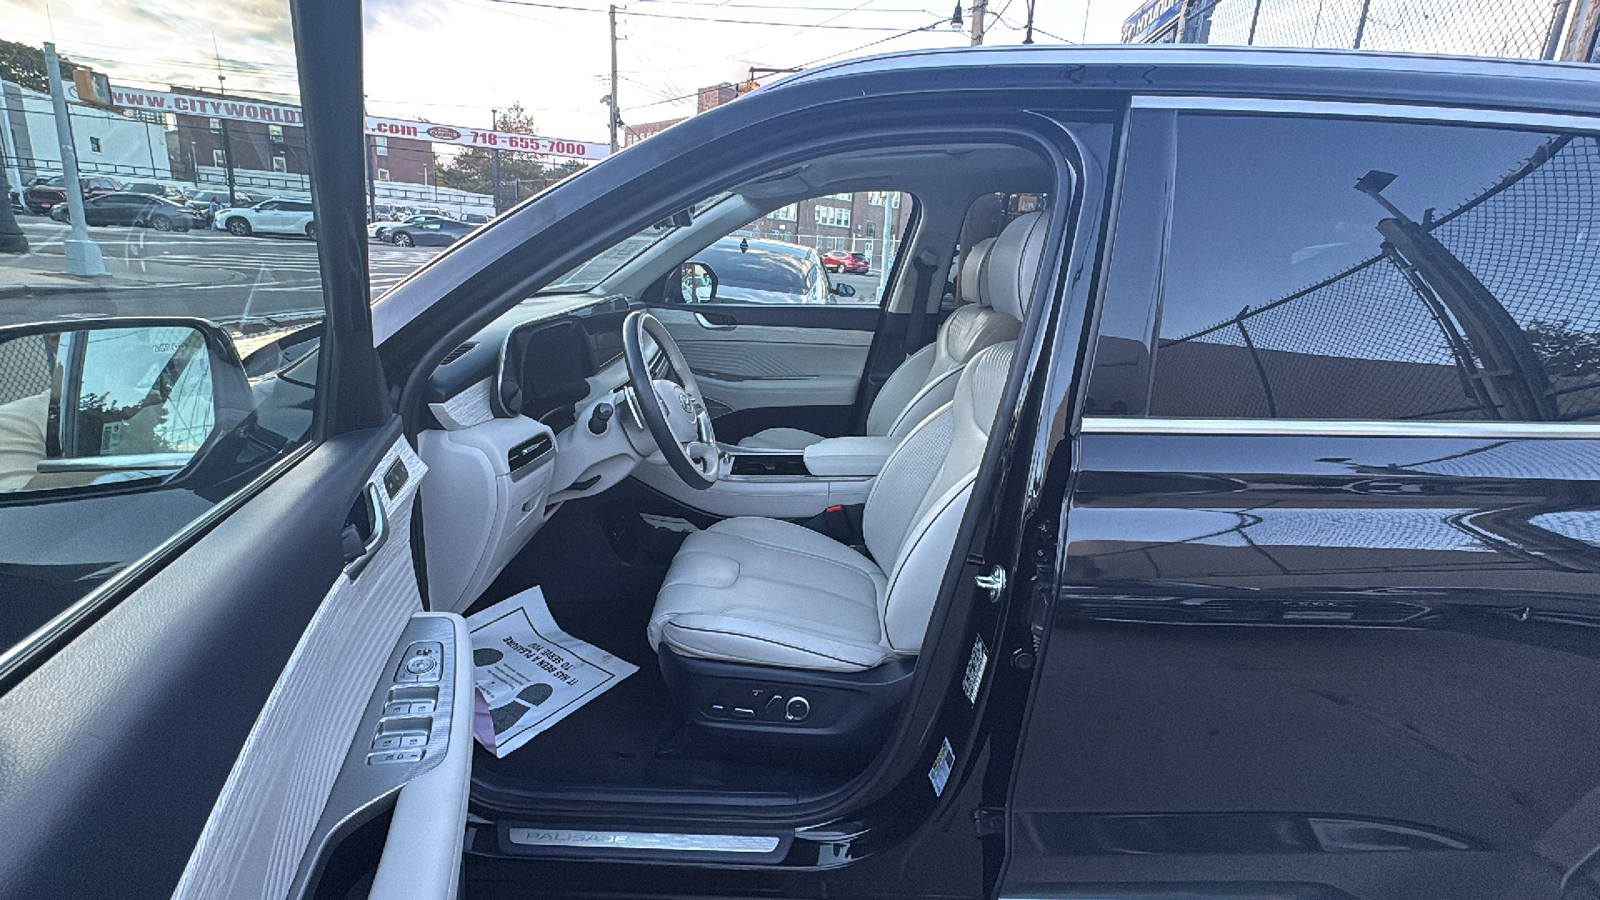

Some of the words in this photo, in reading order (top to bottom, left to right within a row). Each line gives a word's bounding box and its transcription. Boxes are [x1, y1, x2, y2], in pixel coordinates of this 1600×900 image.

[1136, 0, 1179, 35] HYUND
[503, 636, 536, 659] PLEASURE
[541, 648, 564, 664] SERVE
[536, 659, 558, 673] BEEN
[561, 661, 574, 671] TO
[553, 670, 571, 683] HAS
[566, 677, 579, 686] IT
